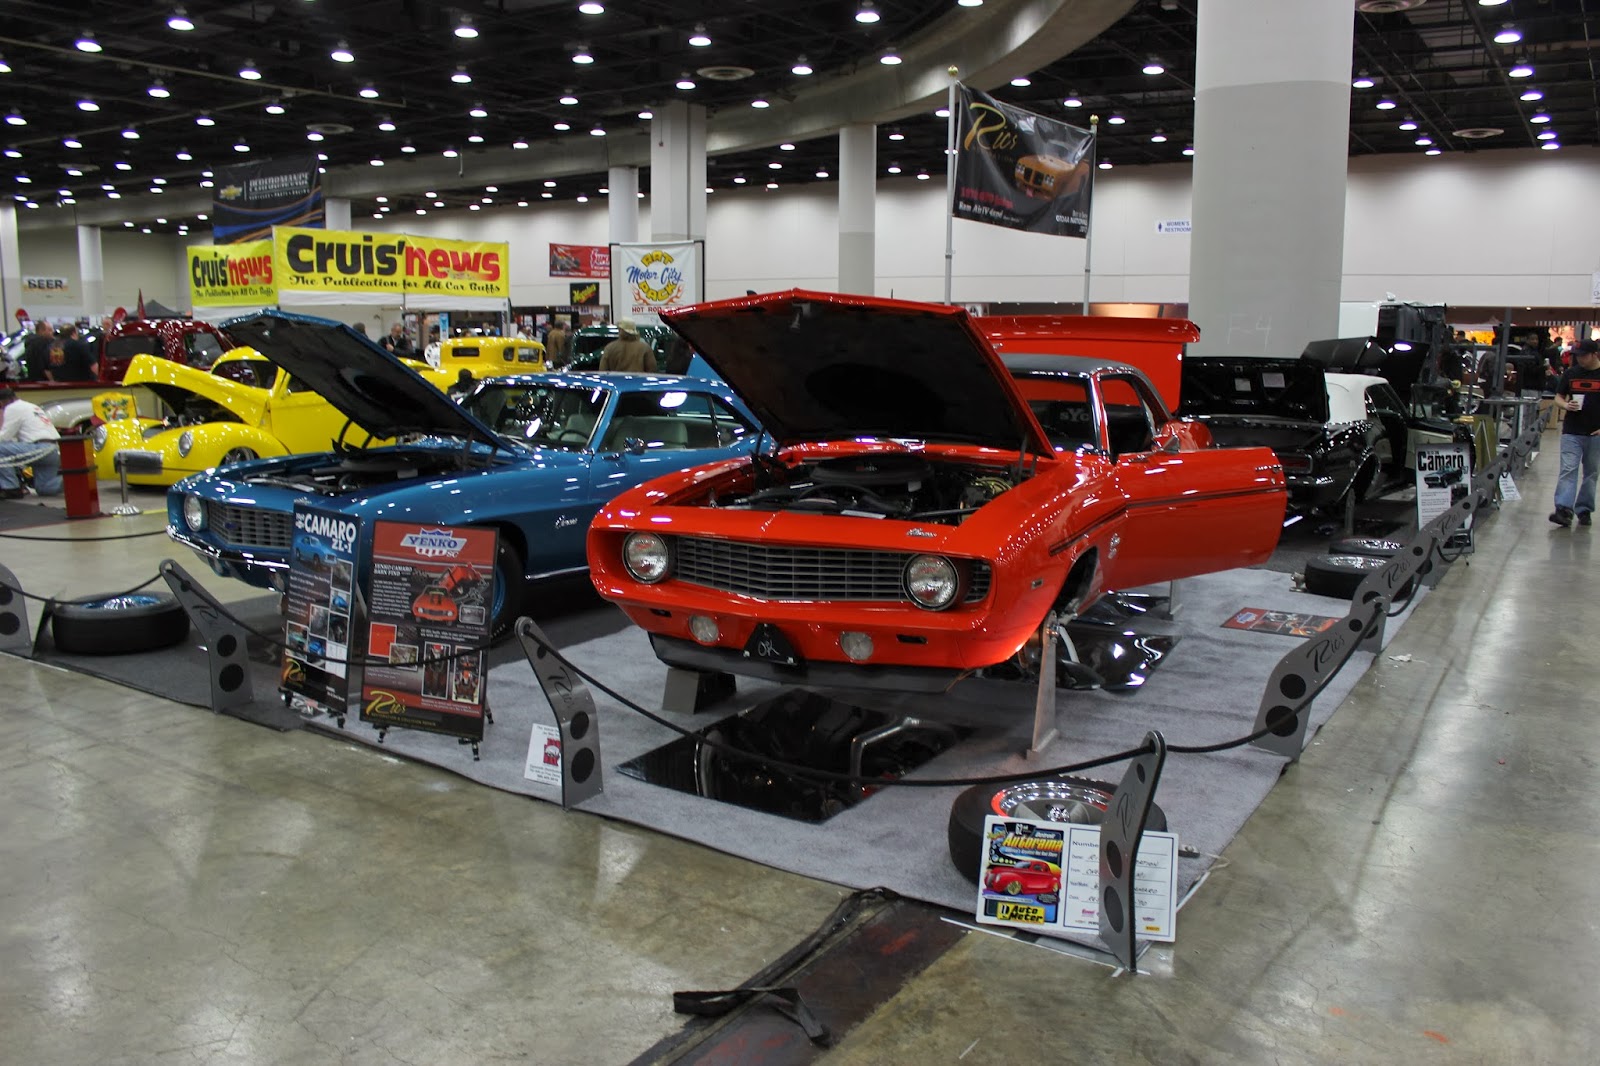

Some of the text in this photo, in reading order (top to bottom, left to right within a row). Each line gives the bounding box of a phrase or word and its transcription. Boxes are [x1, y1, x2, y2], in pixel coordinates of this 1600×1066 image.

[626, 266, 658, 283] Motor
[661, 267, 684, 285] City
[28, 279, 63, 289] BEER
[289, 275, 501, 294] The Publication for All Car Buffs
[638, 280, 678, 302] PACK
[205, 288, 230, 298] Publication
[1417, 451, 1464, 472] Camaro
[304, 513, 357, 543] CAMARO
[332, 538, 352, 554] ZL-1
[408, 535, 458, 549] YENKO
[446, 550, 460, 558] SC
[374, 563, 391, 571] YENKO
[366, 690, 406, 716] Rio's
[1002, 832, 1064, 851] Autorama
[1008, 911, 1043, 921] Meter
[1012, 905, 1038, 914] Auto
